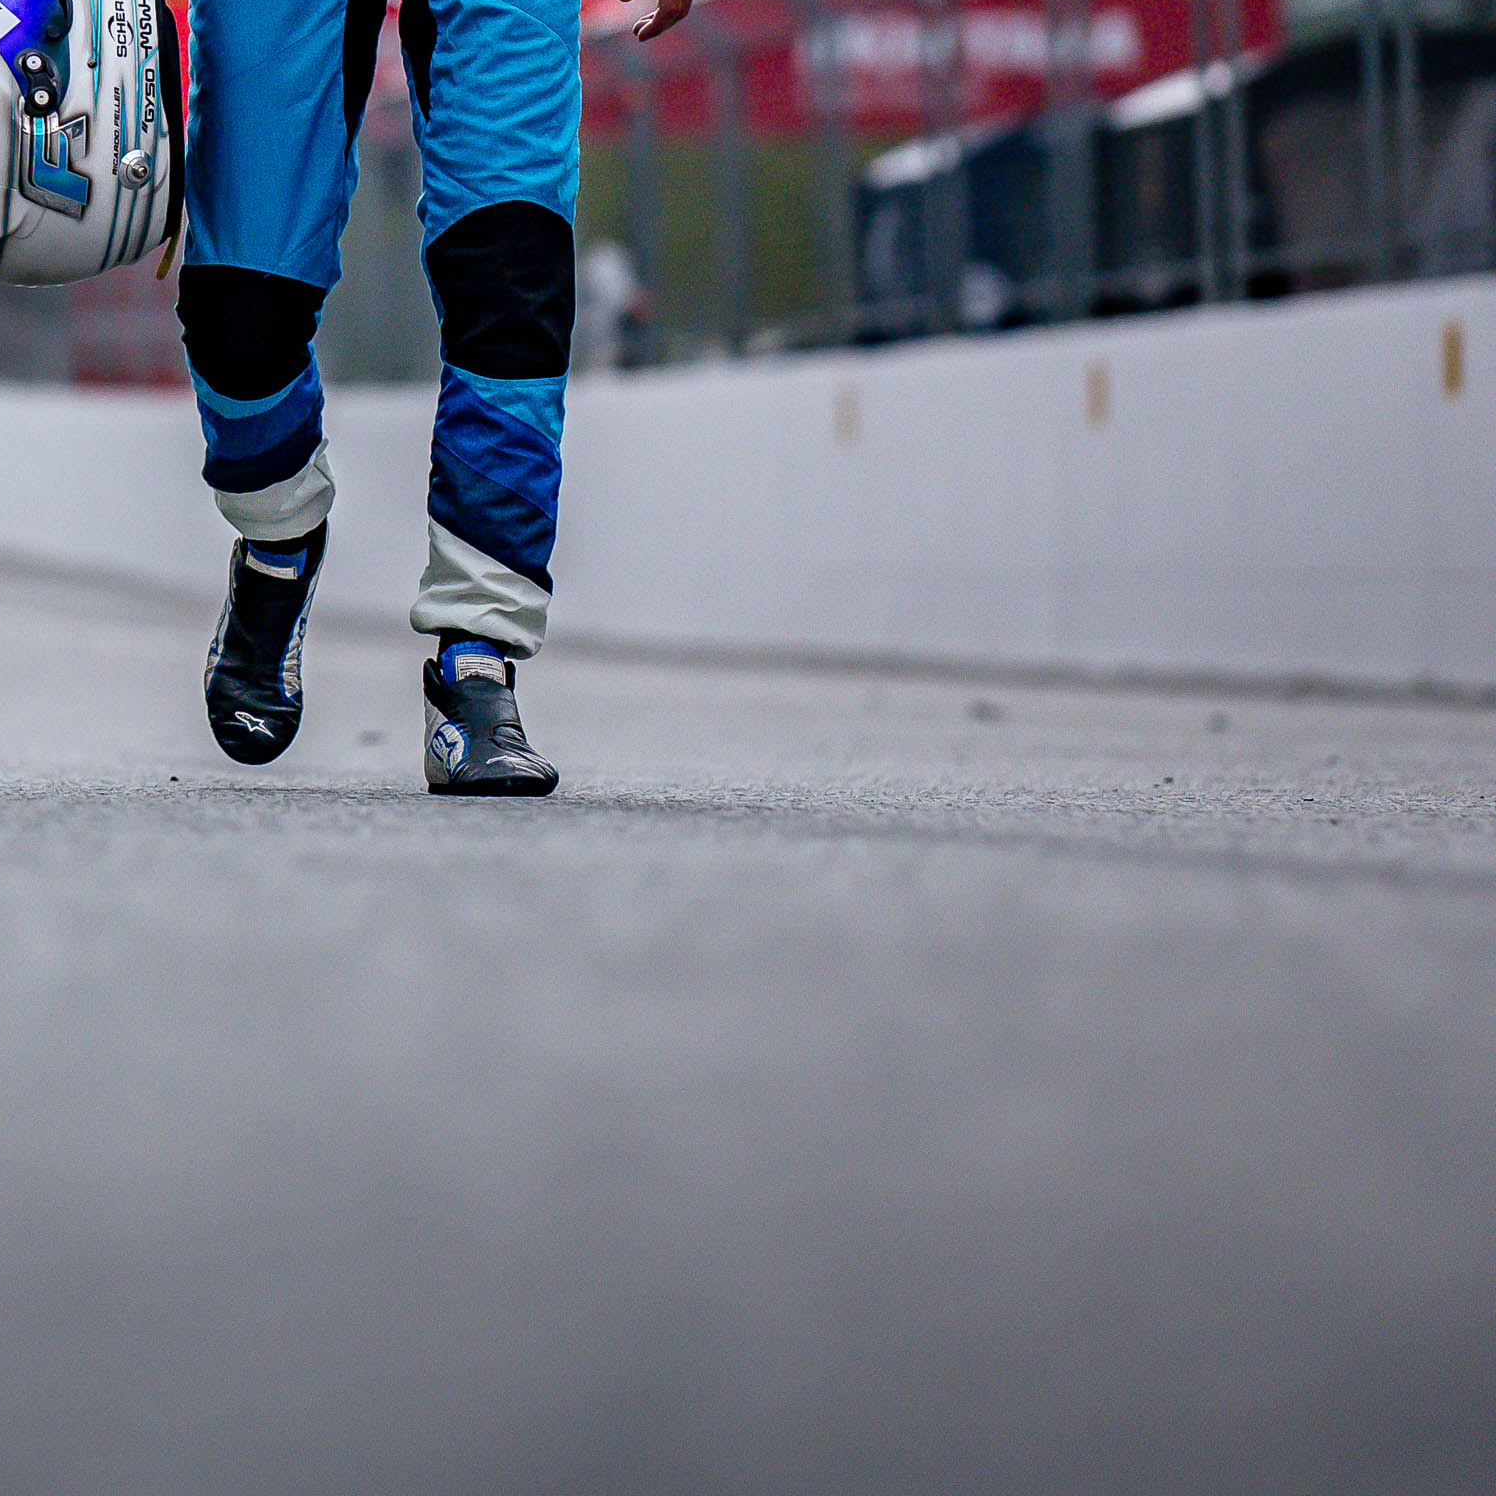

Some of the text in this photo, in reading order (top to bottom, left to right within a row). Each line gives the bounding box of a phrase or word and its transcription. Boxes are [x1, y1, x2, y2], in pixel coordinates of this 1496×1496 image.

[112, 86, 121, 176] RICARDO FELLER
[144, 67, 156, 123] GYSO
